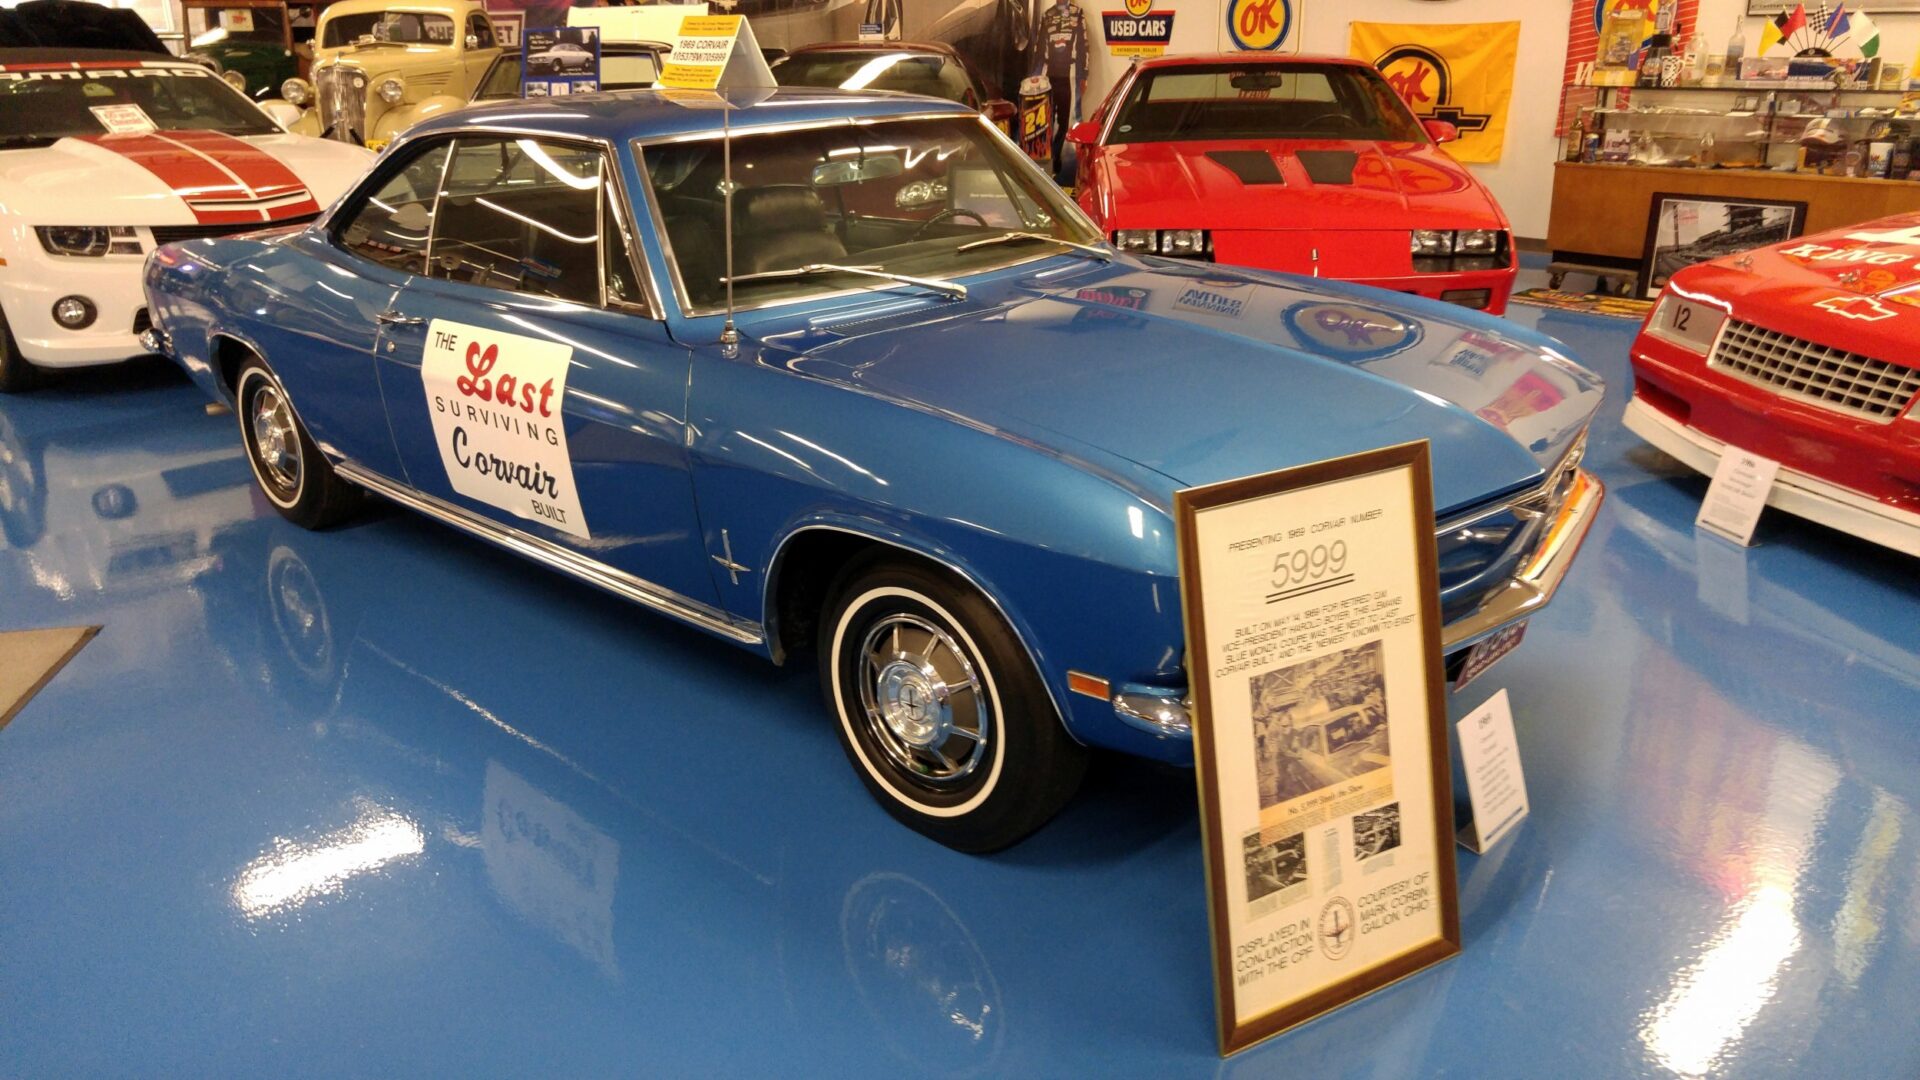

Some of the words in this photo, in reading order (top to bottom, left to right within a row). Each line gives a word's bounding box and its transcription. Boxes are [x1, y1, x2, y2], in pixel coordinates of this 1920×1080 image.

[1110, 20, 1137, 37] USED
[1138, 20, 1166, 37] CARS
[1240, 0, 1279, 37] OK
[679, 40, 695, 50] 1969
[696, 40, 729, 50] CORVAIR
[1025, 103, 1046, 135] 24
[1778, 243, 1915, 265] KING
[1672, 304, 1692, 332] 12
[435, 331, 458, 351] THE
[457, 341, 555, 418] Last
[435, 395, 559, 446] SURVIVING
[452, 426, 559, 499] Corvair
[531, 499, 567, 524] BUILT
[1228, 532, 1282, 552] PRESENTING
[1288, 527, 1306, 539] 1969
[1310, 517, 1345, 534] CORVAIR
[1351, 508, 1383, 524] NUMBER
[1271, 539, 1347, 589] 5999
[1222, 627, 1287, 652] VICE-PRESIDENT
[1289, 618, 1321, 633] HAROLD
[1353, 605, 1370, 616] THIS
[1234, 624, 1257, 638] BUILT
[1260, 622, 1271, 631] ON
[1322, 602, 1338, 612] FOR
[1340, 593, 1371, 609] RETIRED
[1215, 660, 1250, 678] CORVAIR
[1279, 648, 1295, 659] AND
[1297, 642, 1313, 653] THE
[1352, 623, 1380, 638] KNOWN
[1381, 620, 1393, 629] TO
[1225, 650, 1247, 664] BLUE
[1249, 643, 1277, 657] MONZA
[1280, 633, 1308, 648] COUPE
[1310, 628, 1327, 639] WAS
[1328, 623, 1344, 633] THE
[1346, 617, 1365, 629] NEXT
[1367, 613, 1378, 623] TO
[1380, 607, 1400, 621] LAST
[1357, 879, 1411, 908] COURTESY
[1413, 871, 1430, 885] OF
[1360, 902, 1387, 921] MARK
[1391, 886, 1429, 908] CORBIN
[1404, 899, 1430, 917] OHIO
[1236, 923, 1297, 958] DISPLAYED
[1300, 918, 1310, 931] IN
[1236, 932, 1313, 972] CONJUNCTION
[1238, 966, 1264, 987] WITH
[1266, 956, 1288, 974] THE
